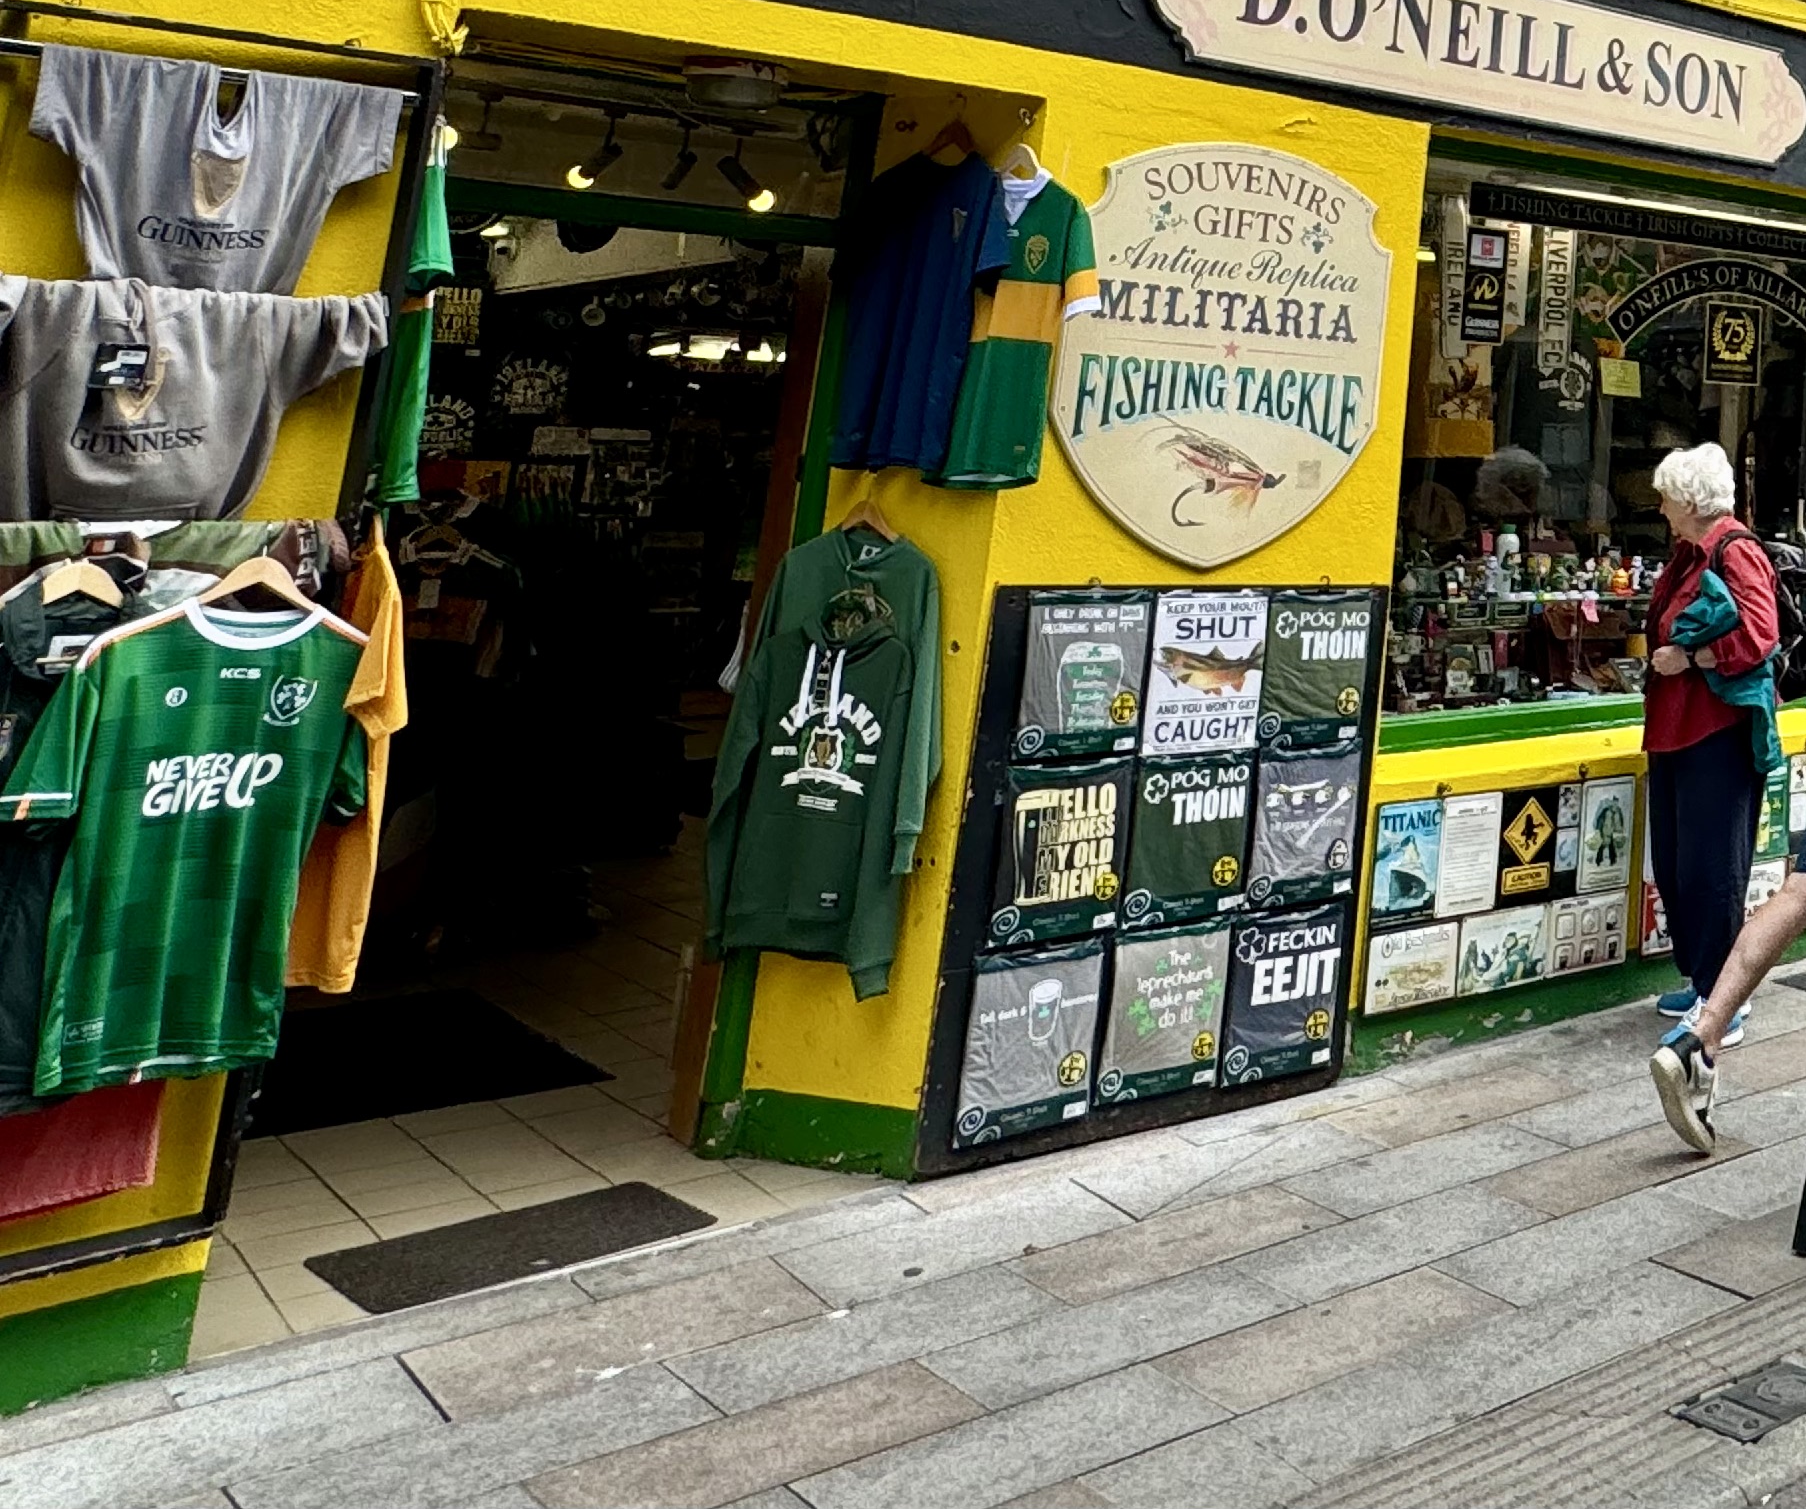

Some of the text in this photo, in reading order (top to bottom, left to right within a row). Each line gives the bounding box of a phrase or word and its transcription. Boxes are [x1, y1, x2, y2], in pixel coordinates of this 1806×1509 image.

[1598, 37, 1633, 96] &
[1643, 39, 1749, 125] SON
[1144, 161, 1347, 226] SOUVENIRS
[1193, 203, 1295, 245] GIFTS
[1501, 191, 1571, 220] FISHING
[1572, 203, 1633, 228] TACKLE
[1648, 212, 1687, 236] IRISH
[136, 215, 269, 251] GUINNESS
[1109, 236, 1360, 294] Antique Replica
[1092, 278, 1358, 344] MILITARIA
[1618, 267, 1708, 331] O'NEILL'S
[1715, 265, 1742, 286] OF
[1723, 317, 1746, 343] 75
[1072, 352, 1363, 455] FISHING TACKLE
[70, 425, 206, 455] GUINNESS
[1166, 601, 1197, 615] KEEP
[1198, 601, 1227, 615] YOUR
[1341, 611, 1370, 627] MO
[1174, 615, 1258, 640] SHUT
[219, 667, 262, 680] KCS
[1156, 699, 1257, 716] AND YOU WON'T GET
[1153, 716, 1255, 744] CAUGHT
[145, 751, 233, 785] NEVER
[1217, 764, 1250, 783] MO
[142, 775, 224, 818] GIVE
[1381, 808, 1442, 834] TITANIC
[1073, 837, 1114, 869] OLD
[1268, 923, 1337, 954] FECKIN
[1168, 950, 1192, 967] The
[1250, 947, 1342, 1007] EEJIT
[1185, 988, 1204, 1002] me
[1158, 1012, 1176, 1029] do
